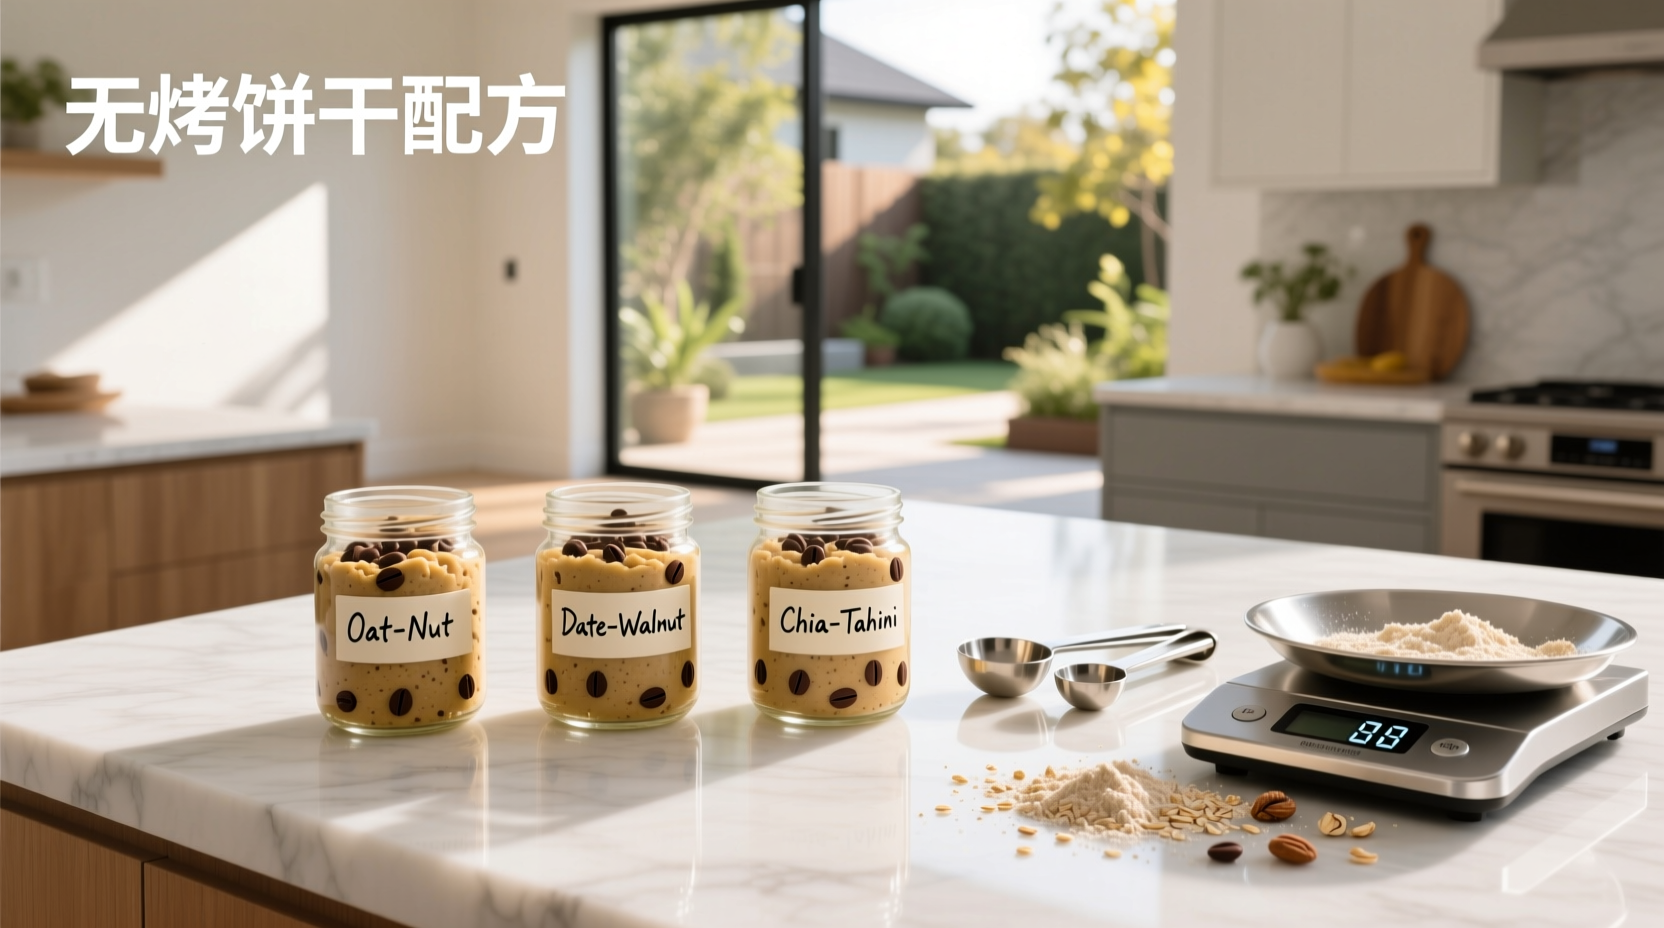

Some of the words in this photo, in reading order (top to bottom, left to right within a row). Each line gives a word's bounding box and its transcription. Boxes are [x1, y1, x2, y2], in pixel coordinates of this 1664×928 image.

[347, 610, 454, 644] Oat-Nut
[560, 606, 686, 638] Date-Walnut
[779, 605, 898, 636] Chia-Tahini
